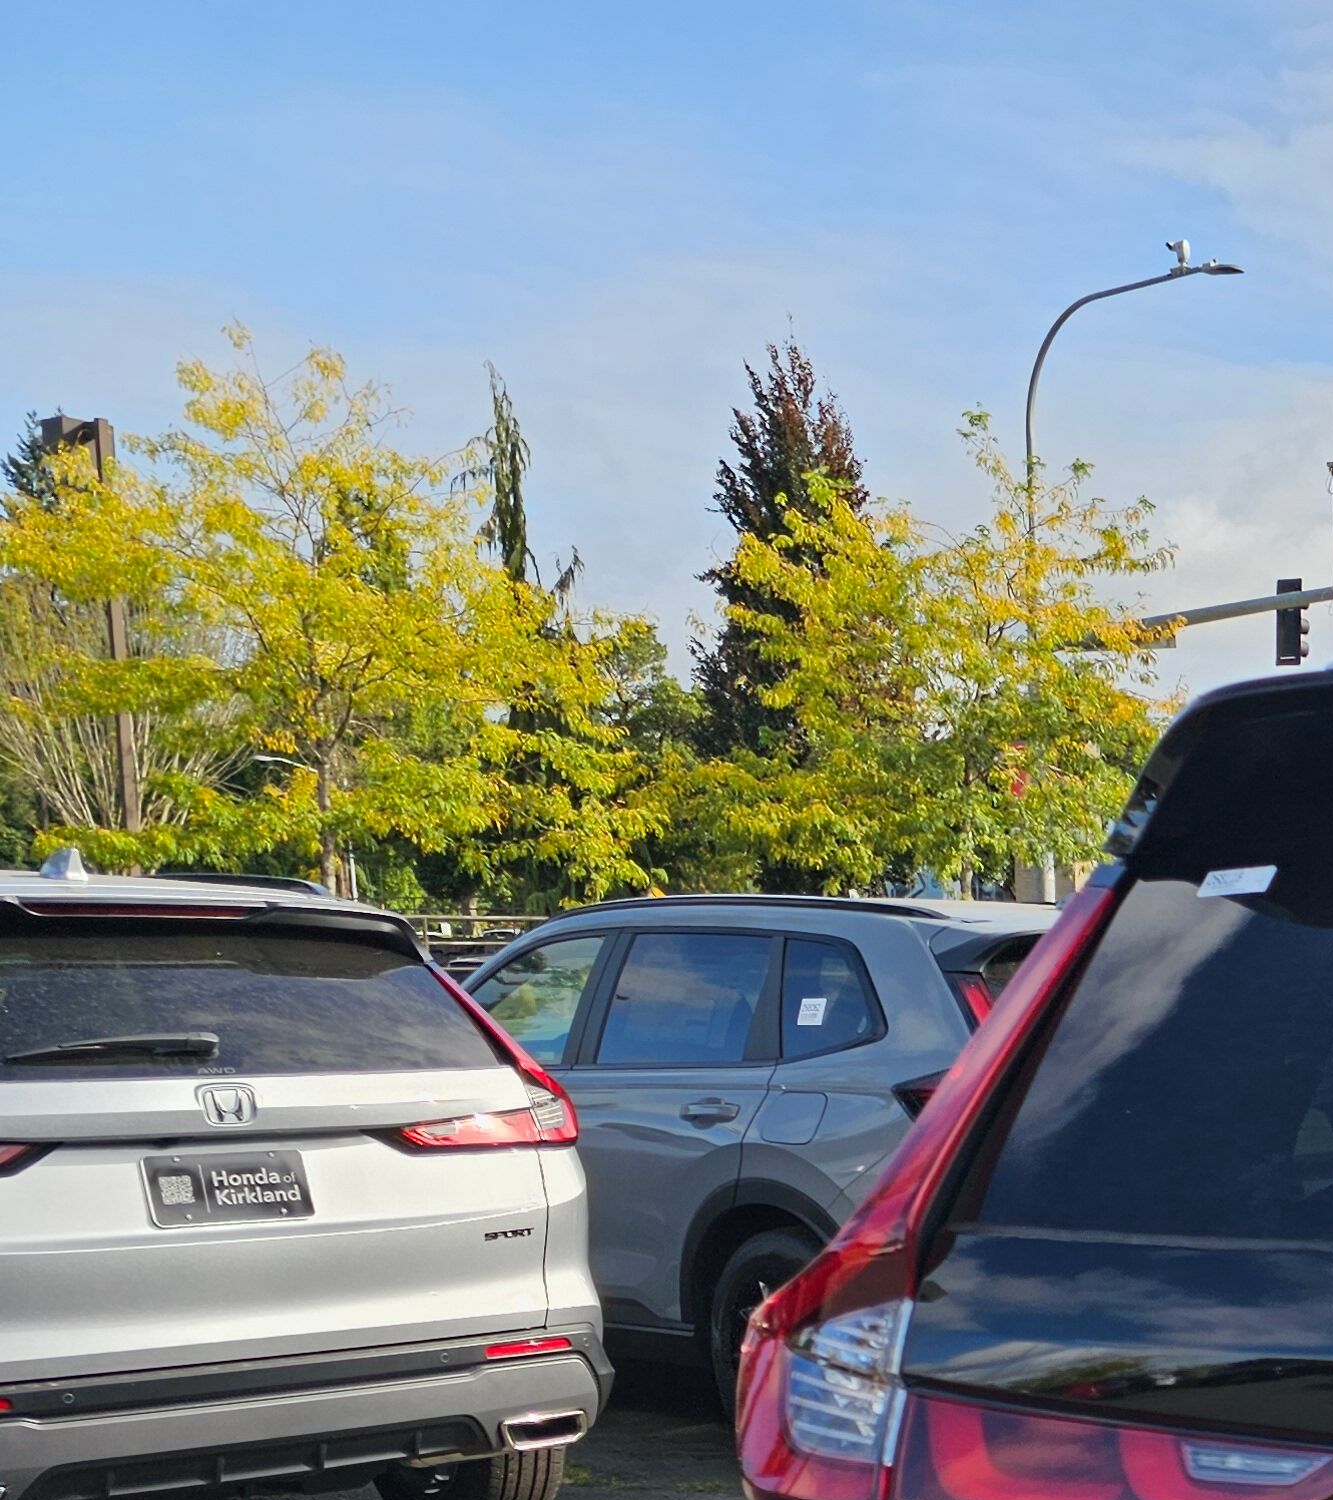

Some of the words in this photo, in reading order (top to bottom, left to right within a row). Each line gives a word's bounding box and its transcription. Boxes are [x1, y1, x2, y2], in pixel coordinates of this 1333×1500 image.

[197, 1066, 236, 1074] AWD
[211, 1168, 280, 1187] Honda
[283, 1172, 296, 1184] of
[214, 1185, 301, 1206] Kirkland
[484, 1227, 535, 1241] SPORT
